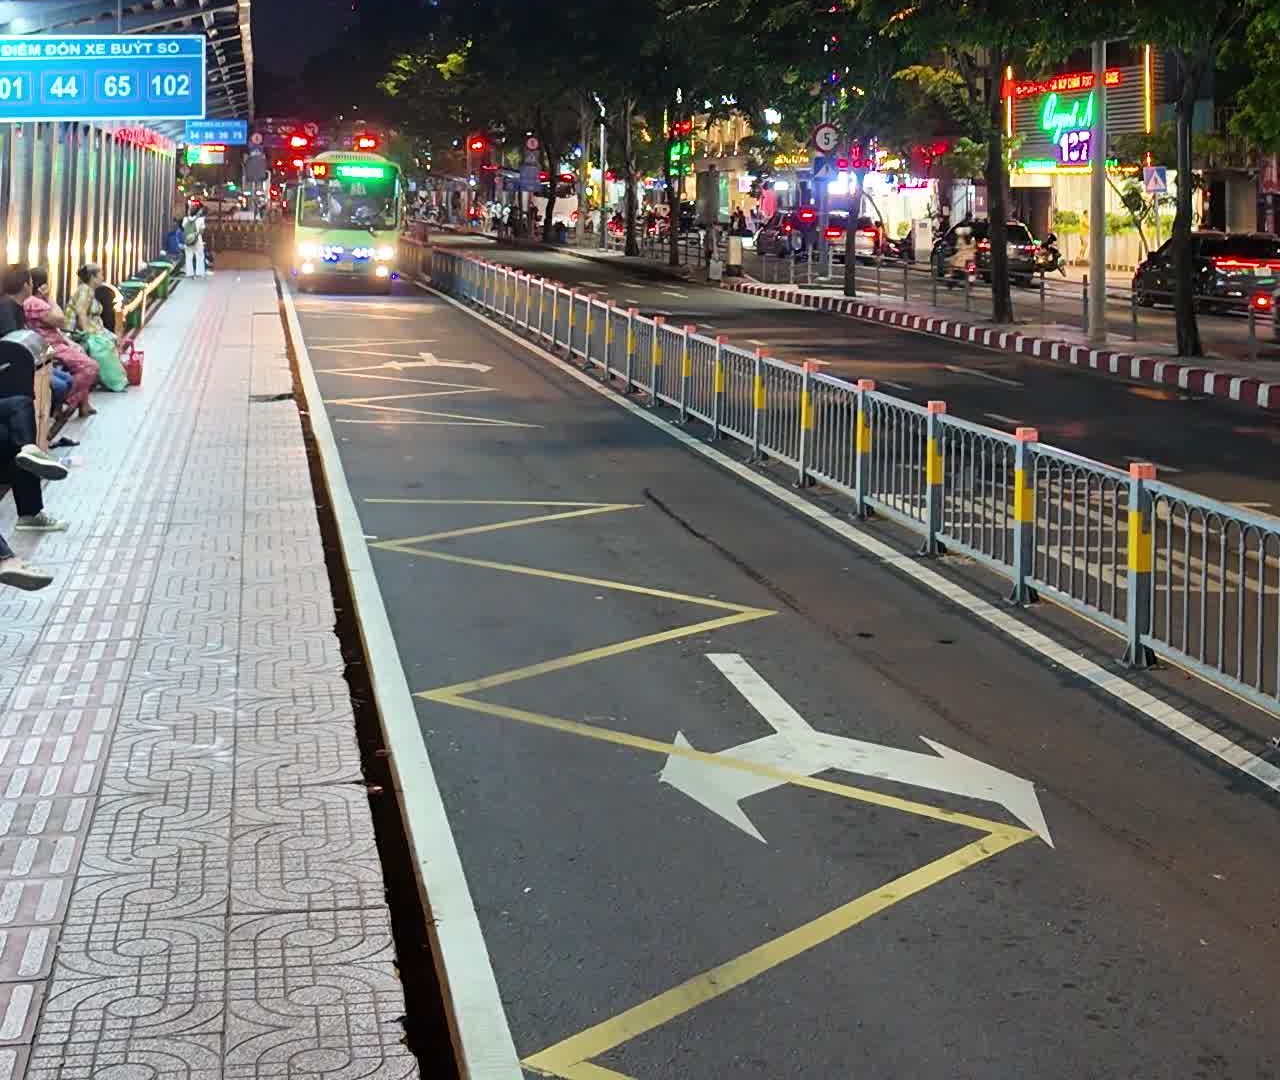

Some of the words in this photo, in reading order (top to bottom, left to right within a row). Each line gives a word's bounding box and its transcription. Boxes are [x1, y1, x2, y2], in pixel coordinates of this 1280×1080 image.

[84, 42, 106, 55] XE
[110, 40, 153, 54] BUÝT
[49, 76, 79, 98] 44
[103, 75, 131, 97] 65
[151, 74, 190, 96] 102
[823, 132, 831, 146] 5
[1059, 131, 1091, 162] 137
